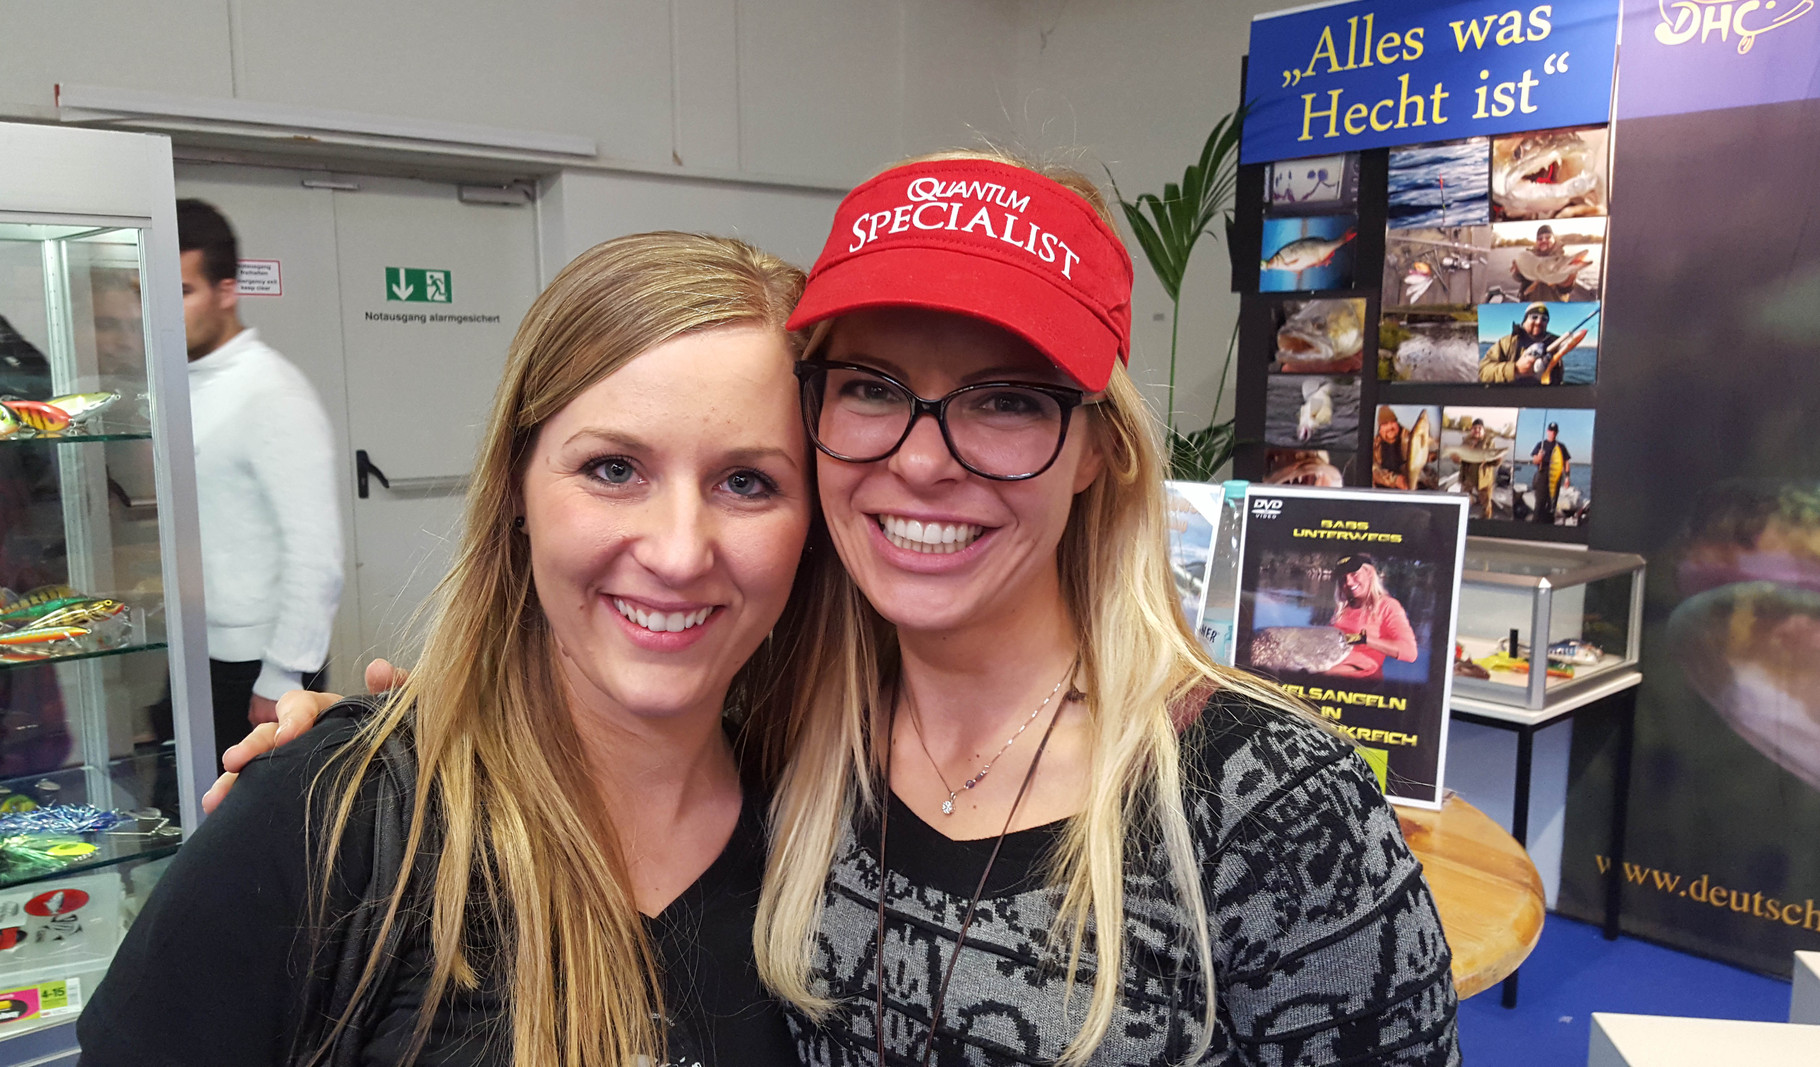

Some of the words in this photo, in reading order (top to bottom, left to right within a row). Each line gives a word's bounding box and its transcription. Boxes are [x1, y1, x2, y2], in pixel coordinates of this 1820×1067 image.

[1282, 13, 1424, 88] „Alles
[1449, 4, 1552, 53] was
[1297, 73, 1449, 141] Hecht
[1472, 52, 1569, 119] ist“
[907, 178, 1030, 213] QUANTUM
[849, 202, 1080, 280] SPECIALIST
[365, 312, 426, 323] Notausgang
[429, 312, 500, 324] alarmgesichert
[1254, 499, 1283, 510] DVD
[1321, 519, 1369, 530] BABS
[1293, 528, 1402, 543] UNTERWEGS
[1321, 706, 1342, 719] IN
[1331, 725, 1418, 747] KREICH
